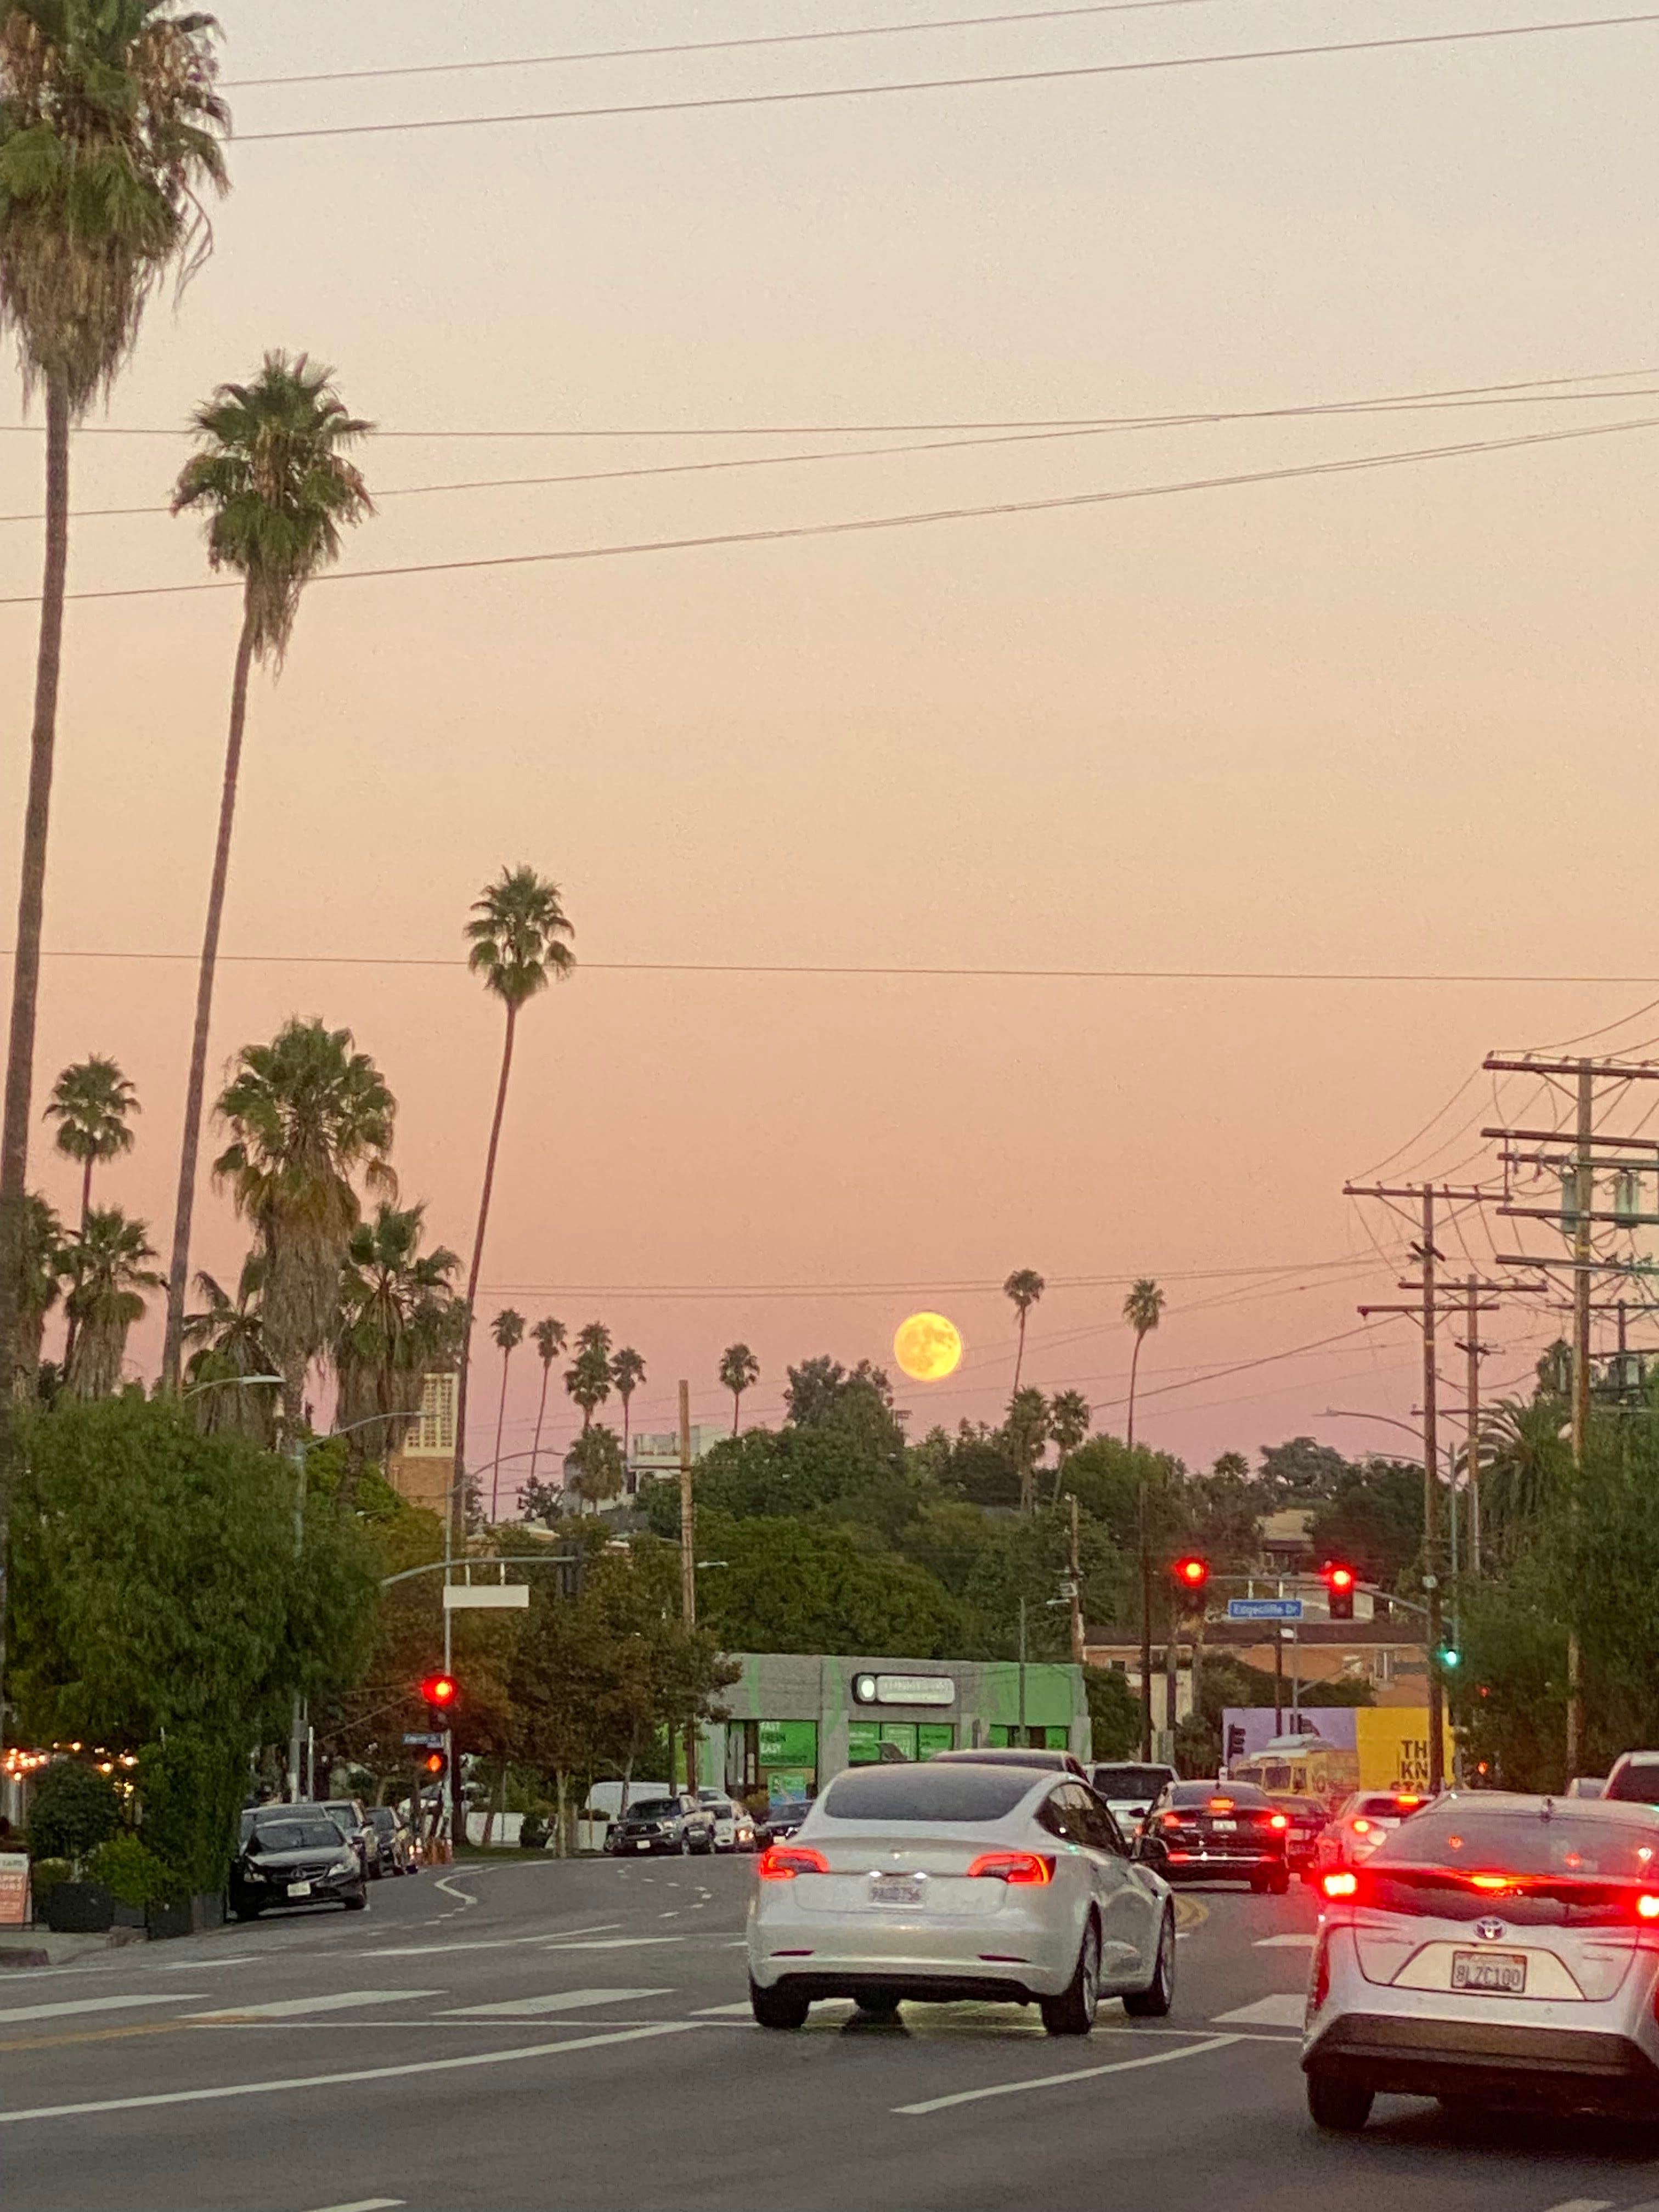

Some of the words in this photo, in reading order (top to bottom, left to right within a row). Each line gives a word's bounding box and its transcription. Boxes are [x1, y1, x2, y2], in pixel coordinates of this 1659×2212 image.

[1285, 1603, 1297, 1615] Dr
[1401, 1740, 1427, 1759] TH
[1401, 1761, 1428, 1779] KN
